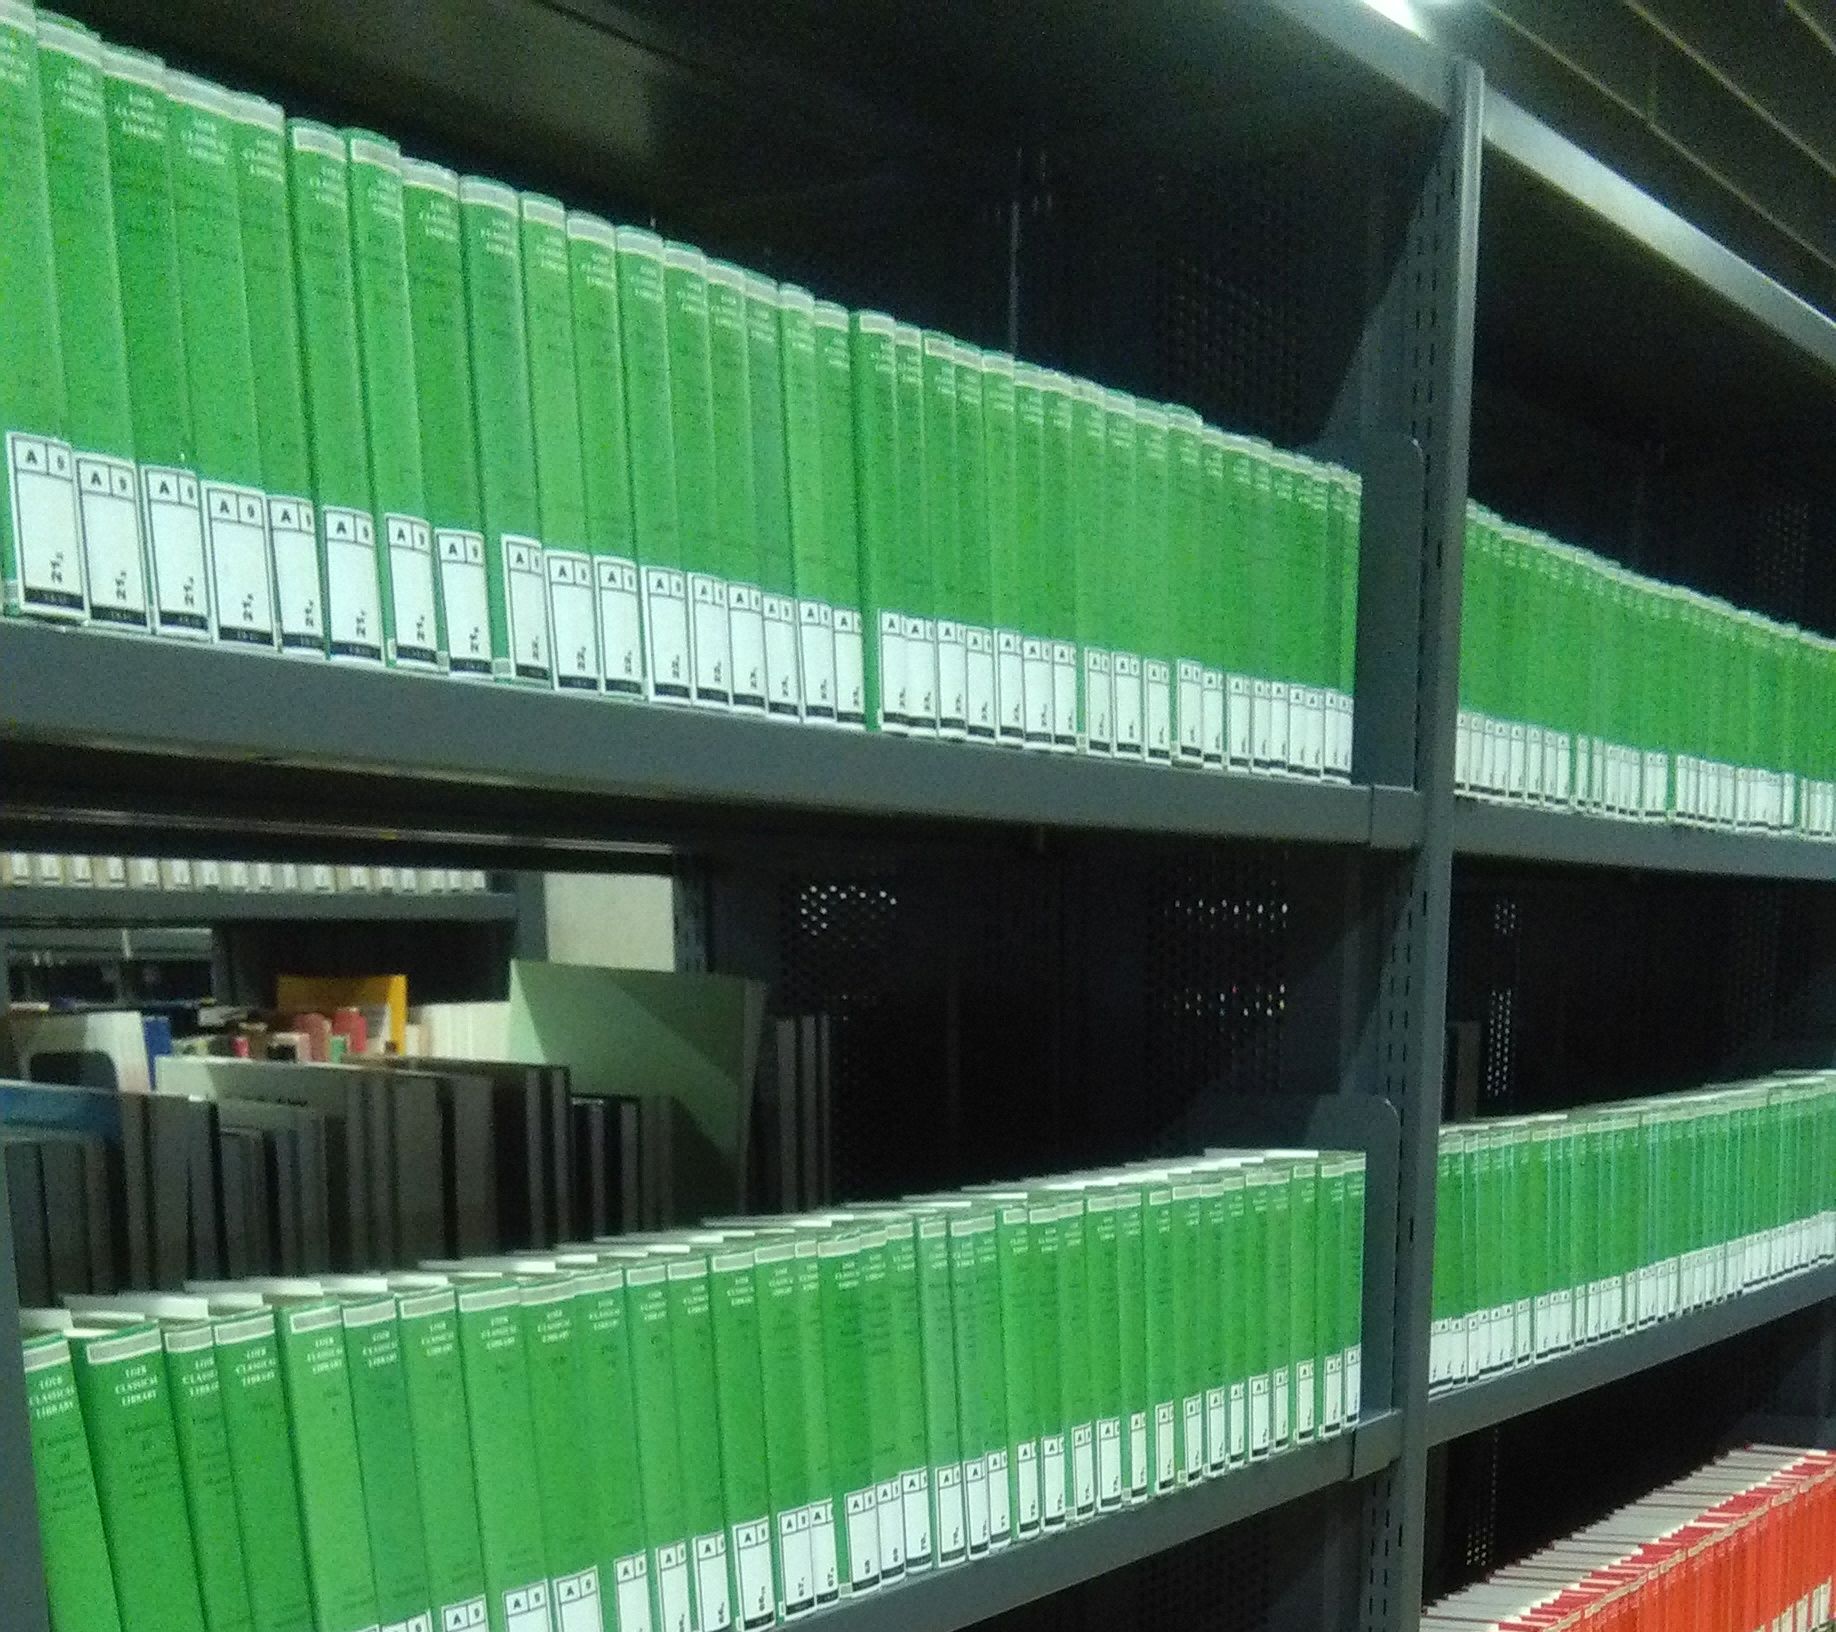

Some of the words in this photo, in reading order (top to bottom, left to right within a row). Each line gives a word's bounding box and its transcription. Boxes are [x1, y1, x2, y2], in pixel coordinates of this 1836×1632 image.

[26, 450, 38, 464] A
[91, 472, 102, 486] A
[159, 481, 170, 495] A
[219, 500, 230, 514] A
[281, 510, 291, 522] A
[336, 521, 347, 534] A
[397, 529, 406, 541] A
[448, 543, 458, 555] A
[516, 552, 524, 564] A
[558, 565, 567, 577] A
[368, 1352, 397, 1367] LIBRARY
[312, 1360, 342, 1375] LIBRARY
[242, 1371, 275, 1387] LIBRARY
[122, 1390, 156, 1407] LIBRARY
[36, 1402, 73, 1419] LIBRARY
[744, 1533, 752, 1542] A
[704, 1544, 711, 1553] A
[665, 1553, 672, 1564] A
[623, 1566, 629, 1576] A
[566, 1586, 574, 1596] A
[513, 1598, 521, 1609] A
[453, 1614, 461, 1625] A
